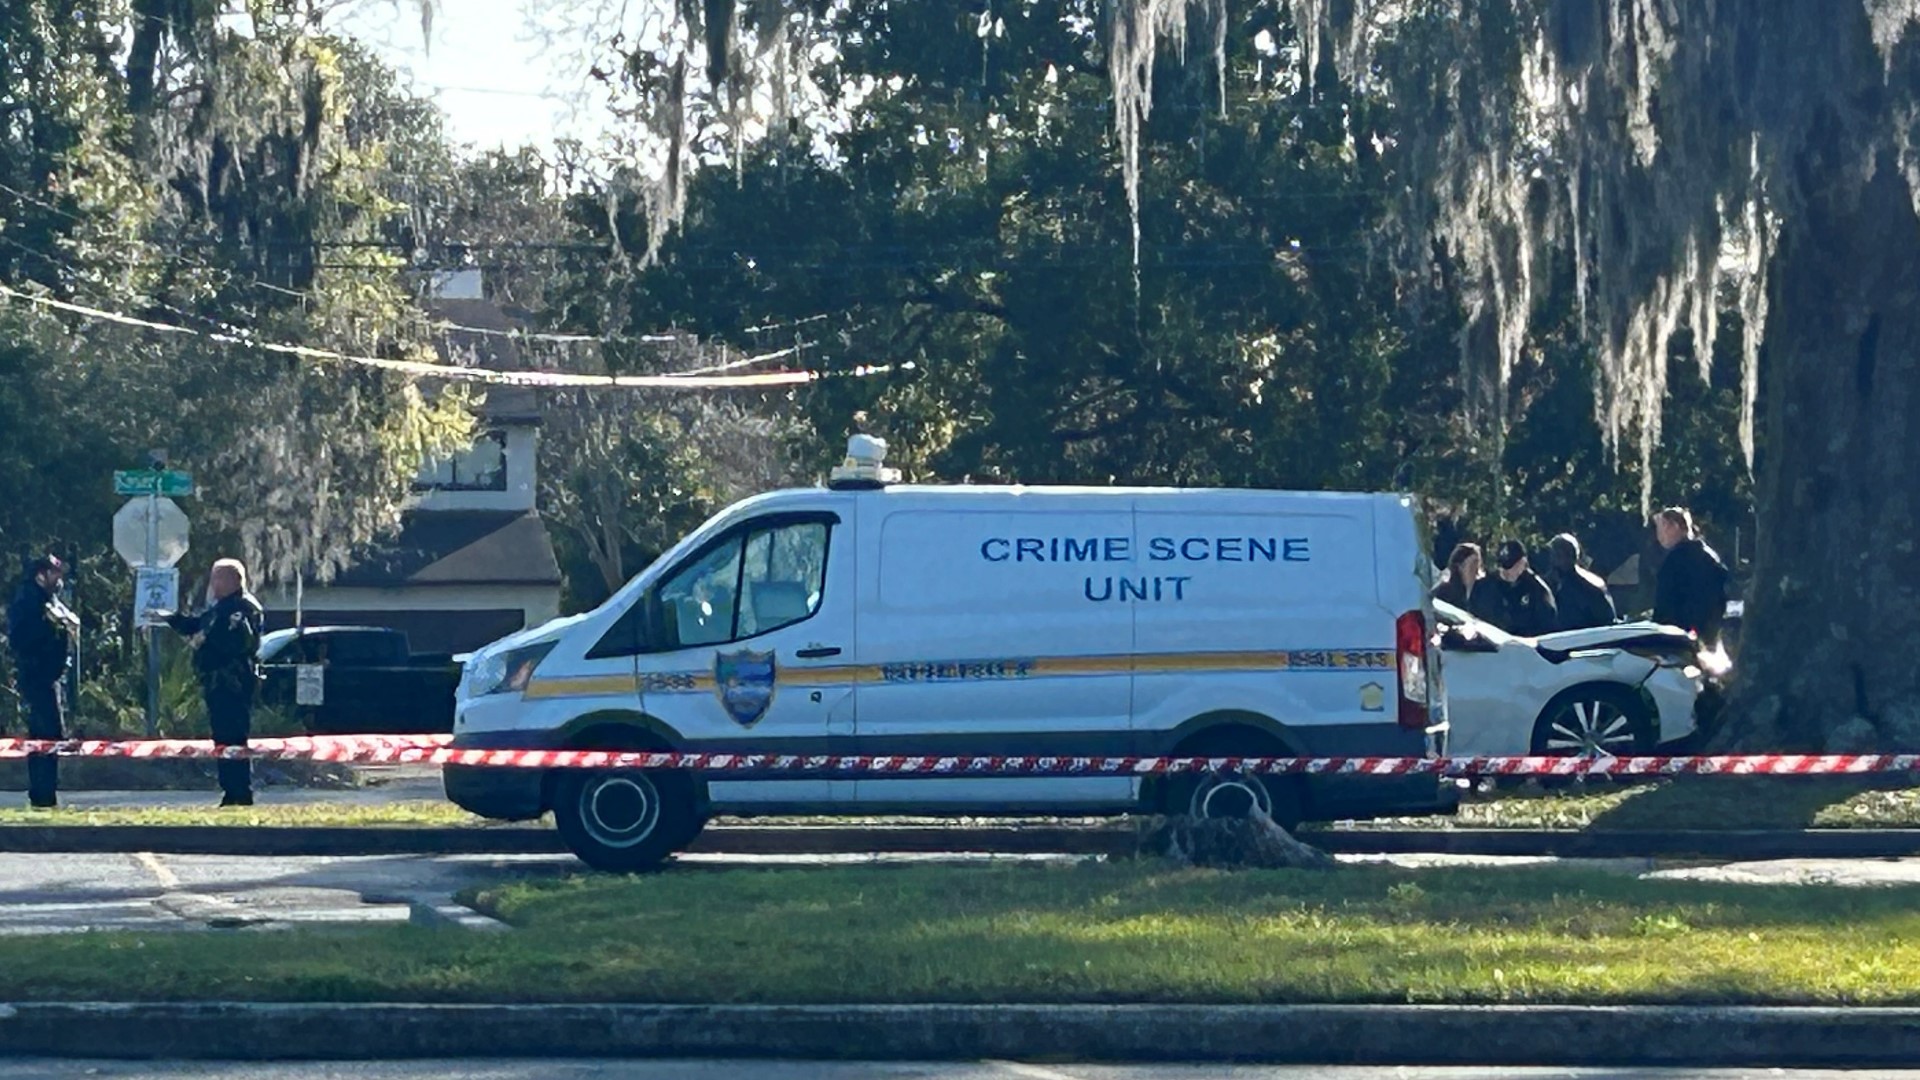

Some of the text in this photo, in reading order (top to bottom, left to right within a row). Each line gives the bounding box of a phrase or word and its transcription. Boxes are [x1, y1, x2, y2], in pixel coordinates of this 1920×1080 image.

[980, 537, 1311, 562] CRIME SCENE
[1084, 576, 1192, 602] UNIT
